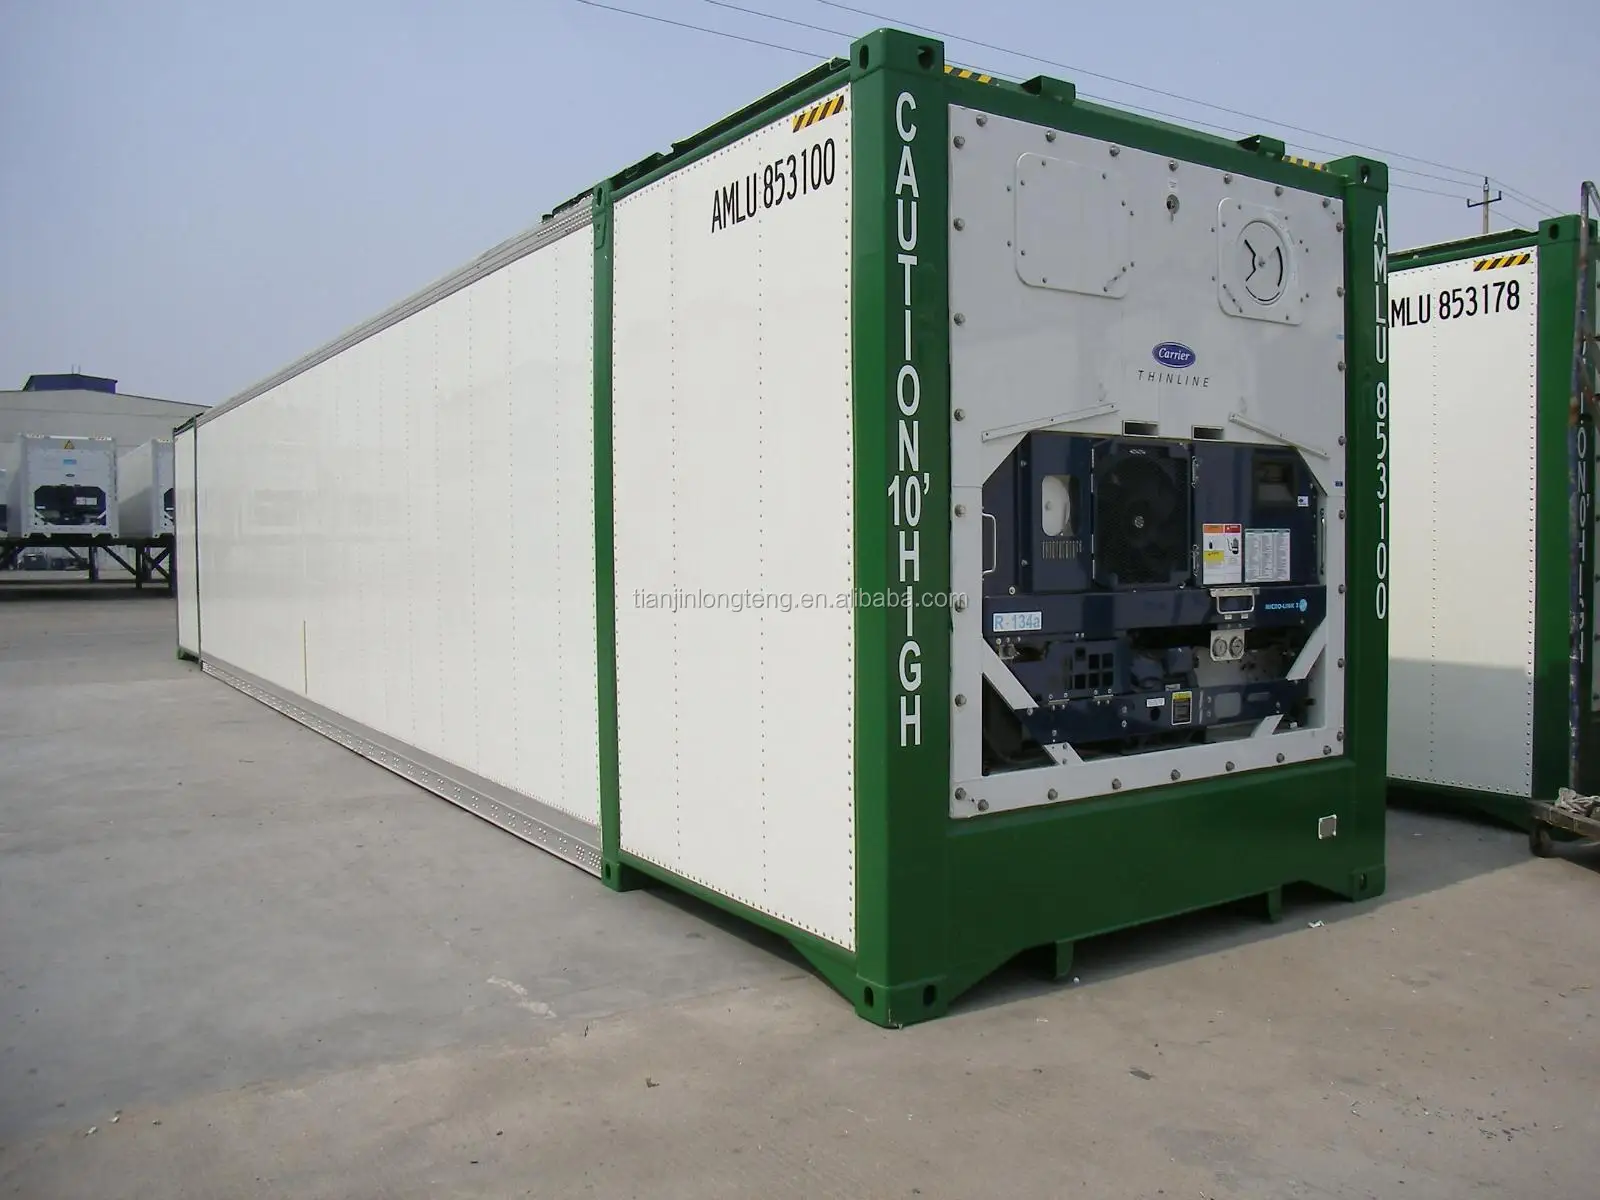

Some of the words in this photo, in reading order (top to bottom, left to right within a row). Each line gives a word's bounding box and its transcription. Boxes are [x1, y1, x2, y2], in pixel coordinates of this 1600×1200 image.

[711, 172, 758, 233] AMLU
[763, 138, 835, 209] 853100
[895, 91, 920, 472] CAUTION
[1374, 205, 1387, 364] AMLU
[1388, 293, 1431, 328] MLU
[1439, 279, 1520, 320] 853178
[1138, 369, 1209, 388] THINLINE
[1158, 347, 1191, 361] Carrier
[1376, 381, 1387, 620] 853100
[899, 530, 922, 747] HIGH
[994, 613, 1041, 630] R-134a
